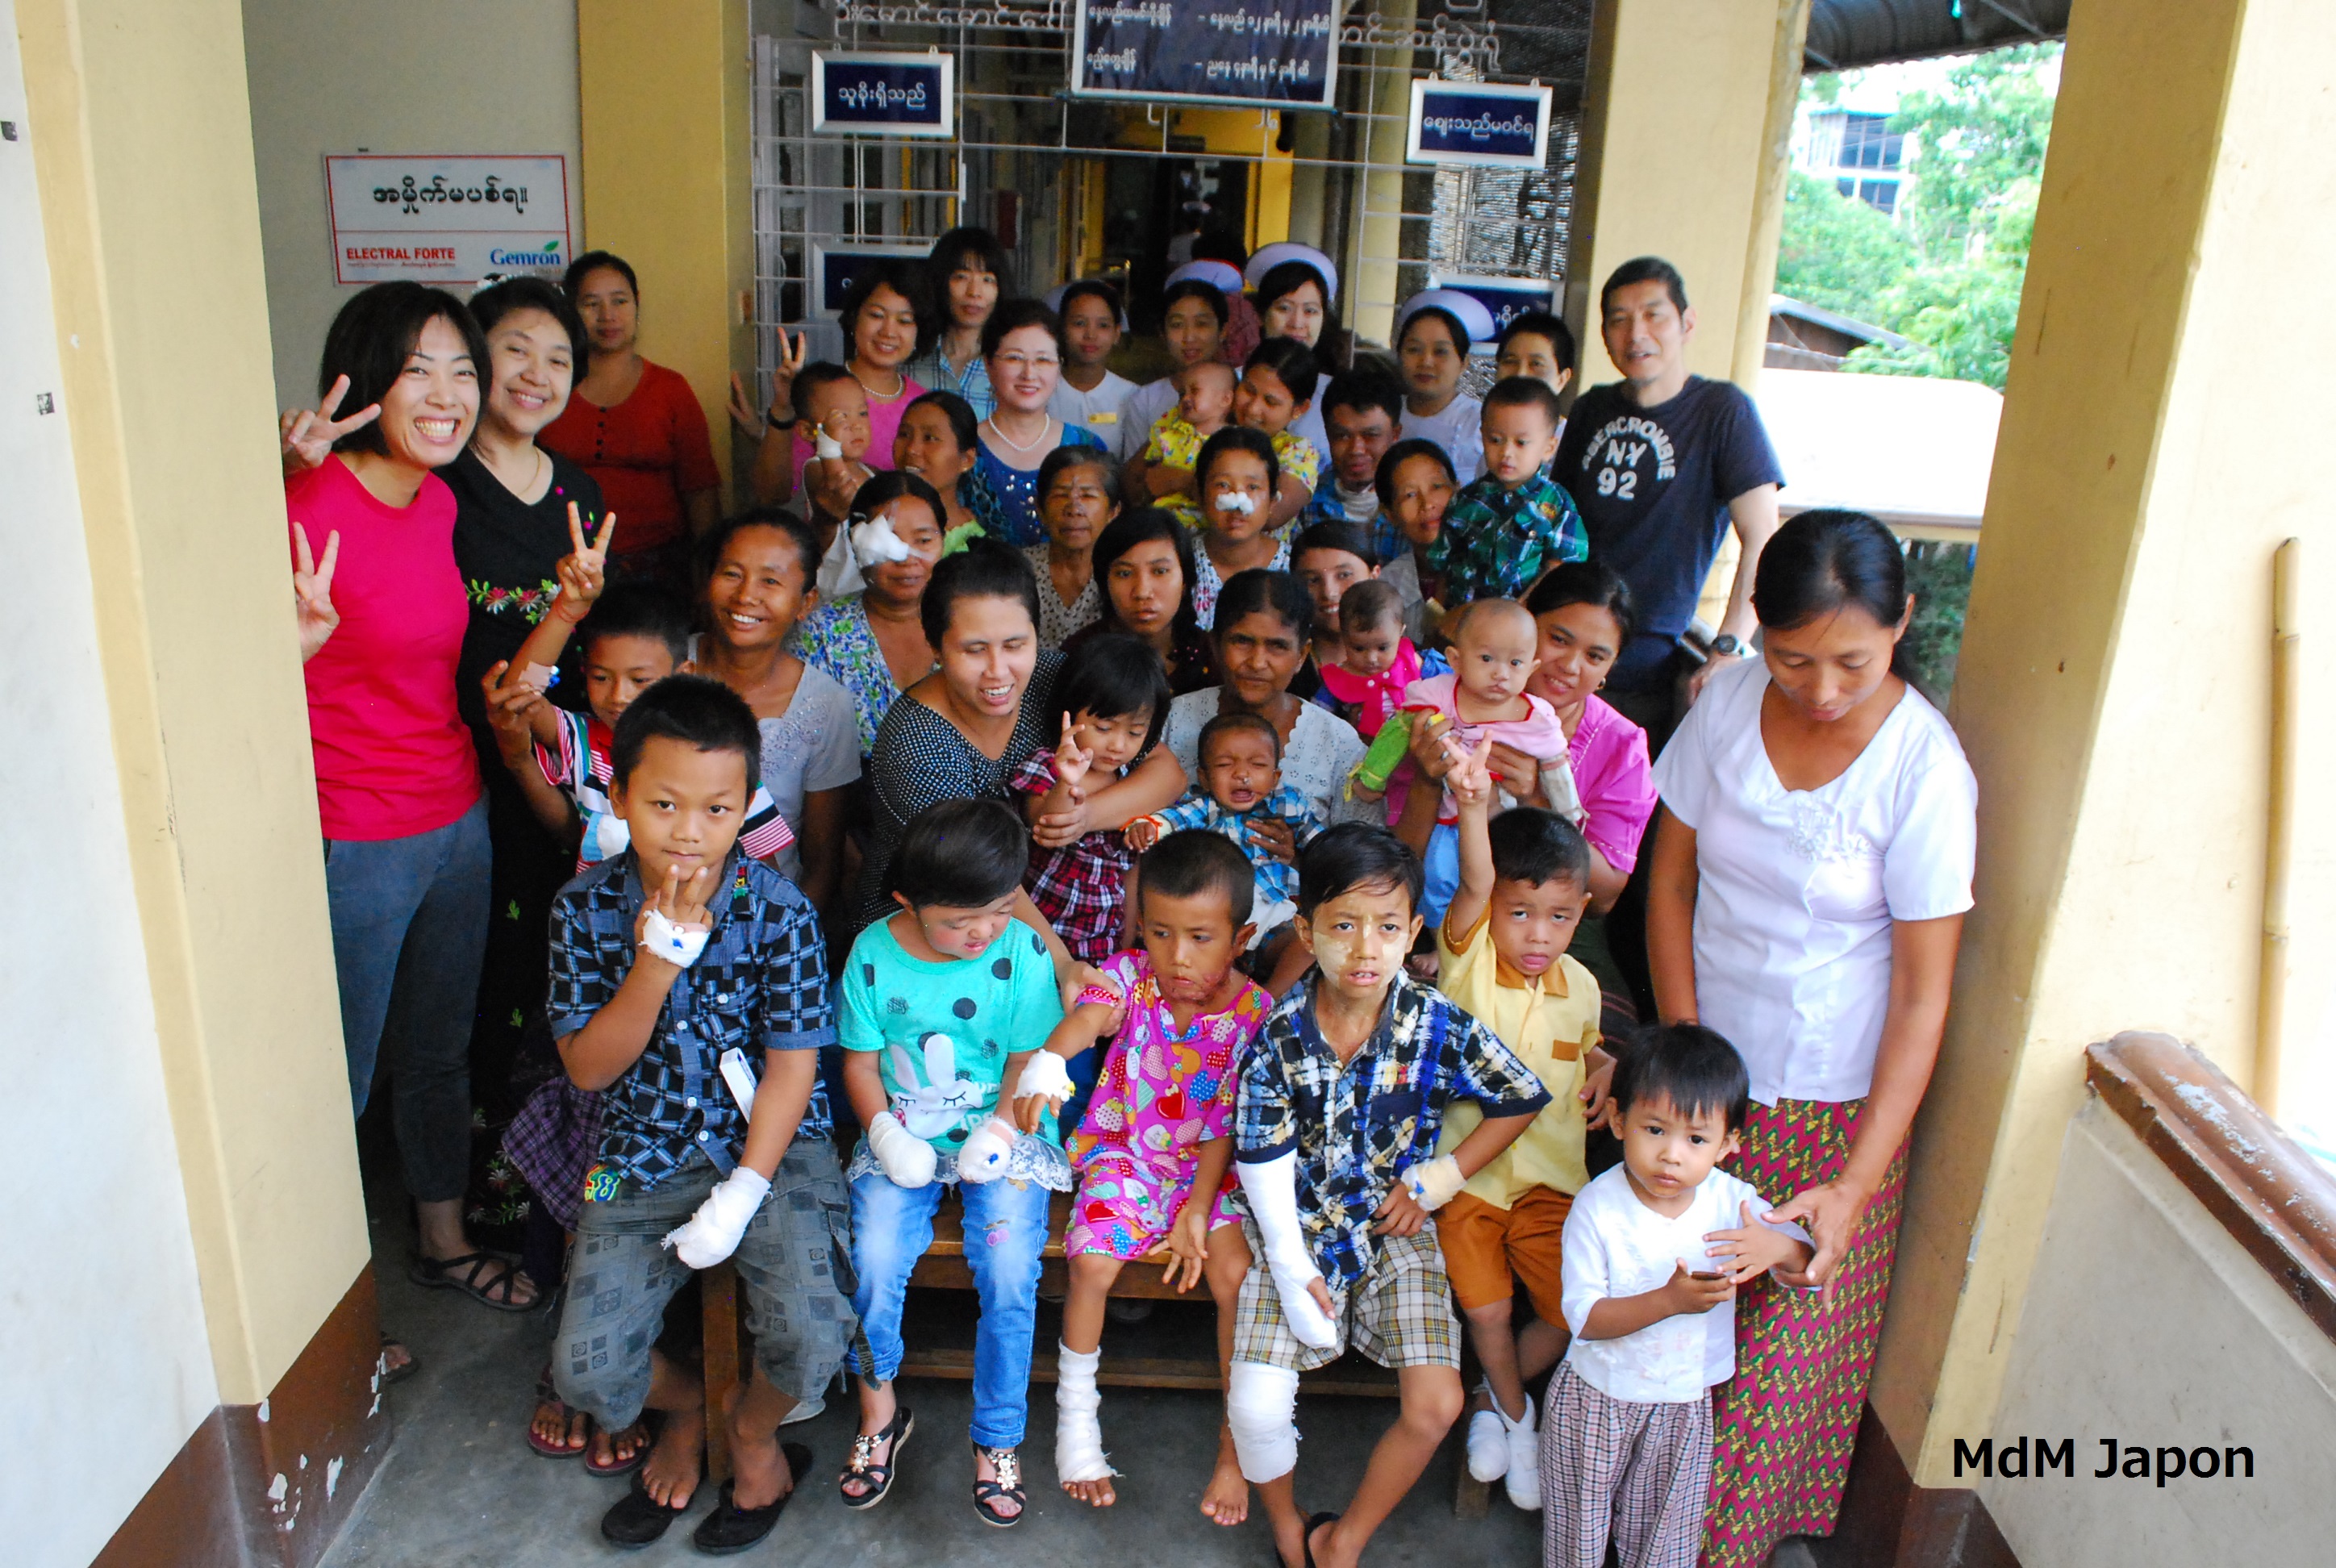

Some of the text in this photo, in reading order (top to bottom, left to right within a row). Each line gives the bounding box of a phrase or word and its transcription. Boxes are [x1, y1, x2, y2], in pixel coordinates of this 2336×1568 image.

[837, 81, 927, 110] သူခိုးရှိသည်
[347, 248, 456, 260] ELECTRAL FORTE
[490, 248, 561, 265] Gemron
[1604, 439, 1647, 468] NY
[1597, 467, 1637, 501] 92
